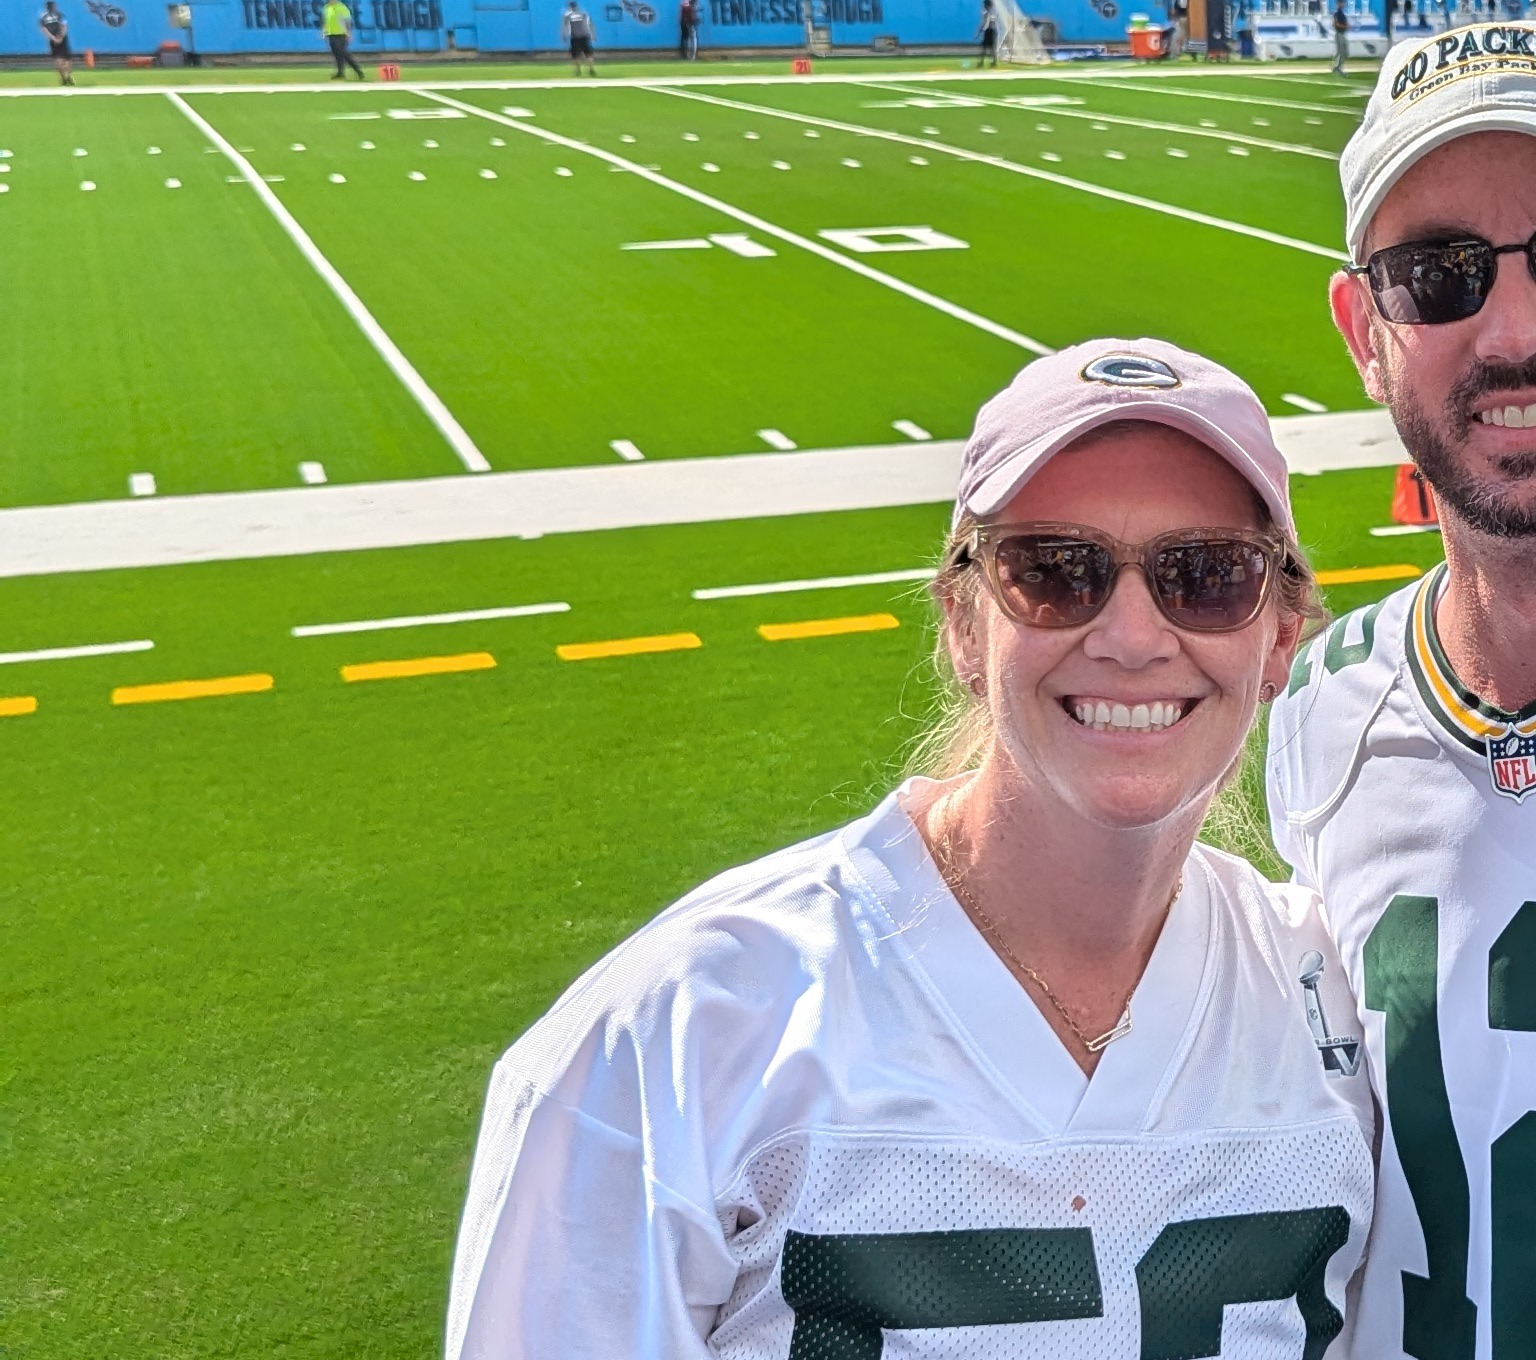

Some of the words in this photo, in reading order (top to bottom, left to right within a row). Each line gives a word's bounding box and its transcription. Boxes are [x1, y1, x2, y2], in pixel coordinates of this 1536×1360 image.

[371, 0, 443, 29] TOUGH
[1391, 51, 1428, 100] GO
[1435, 27, 1535, 70] PACK
[1409, 72, 1454, 101] Green
[1459, 61, 1493, 75] Bay
[1495, 759, 1536, 789] NFL
[1326, 1035, 1358, 1045] BOWL
